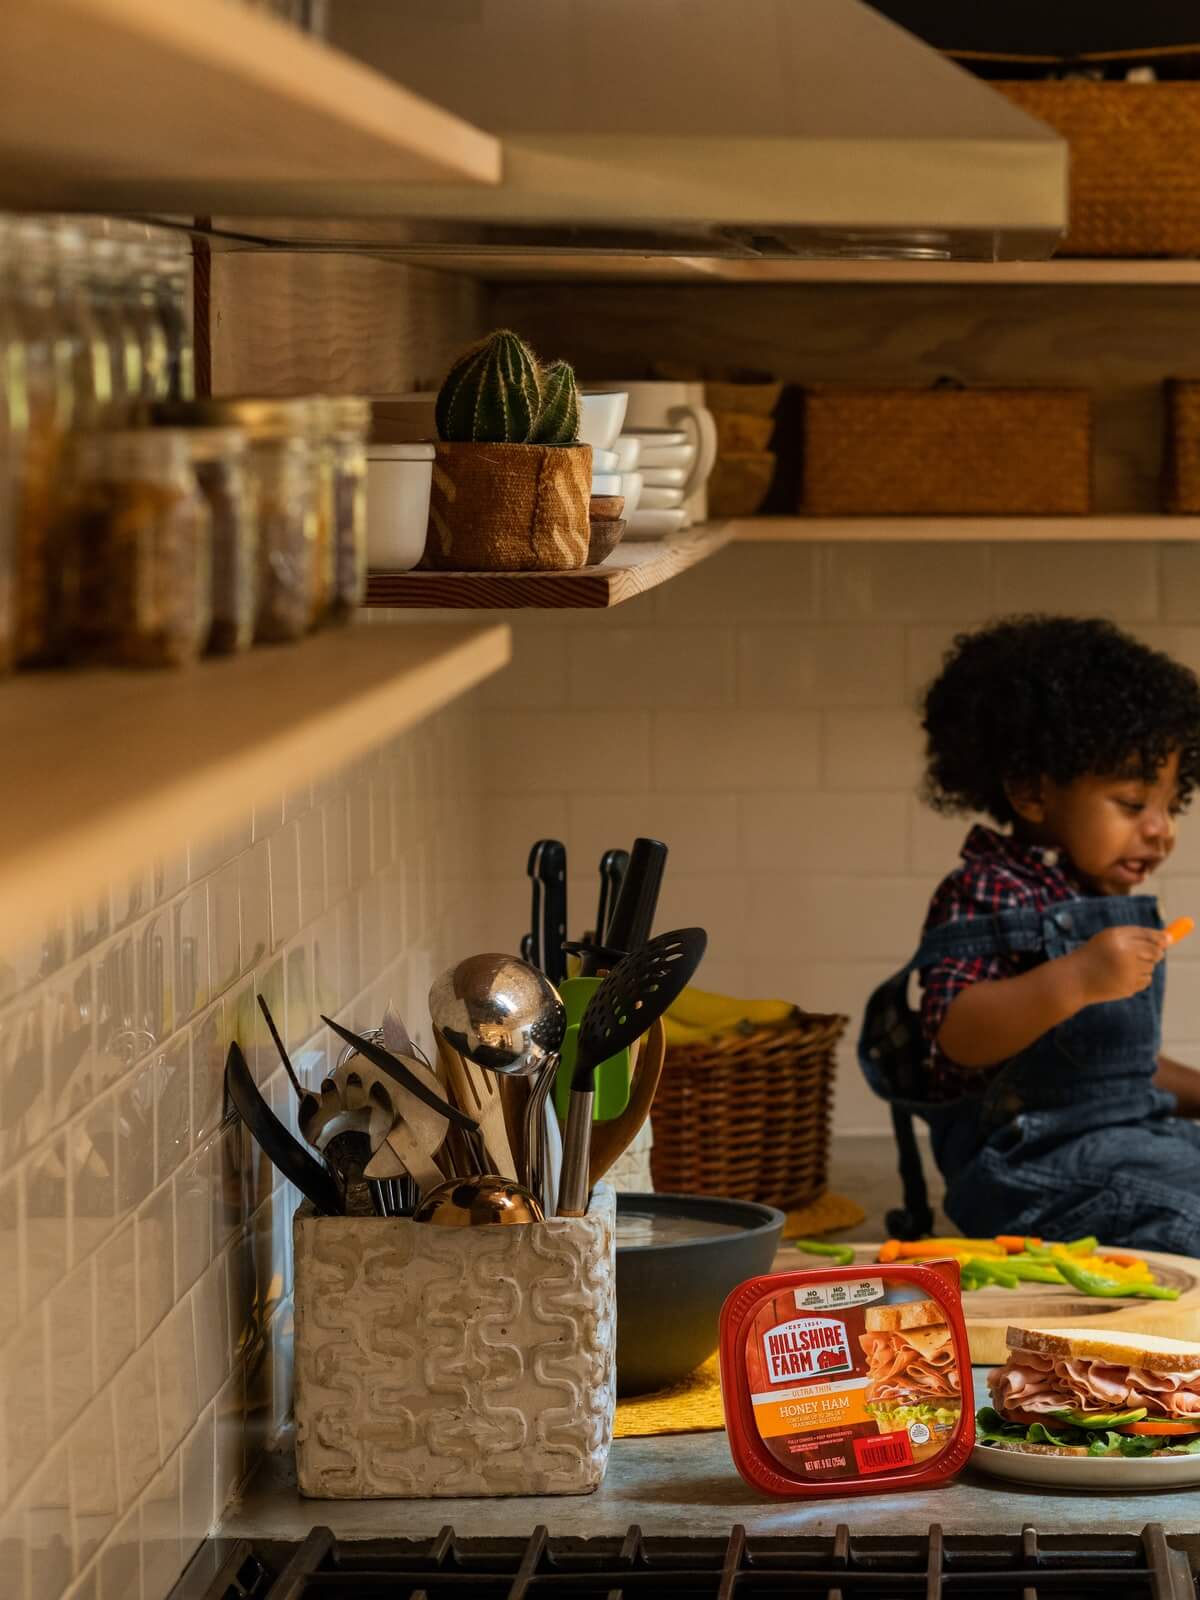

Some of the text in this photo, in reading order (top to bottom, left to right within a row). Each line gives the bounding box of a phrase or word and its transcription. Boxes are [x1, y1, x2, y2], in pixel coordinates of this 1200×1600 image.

[768, 1325, 844, 1355] HILLSHIRE
[771, 1351, 813, 1377] FARM
[792, 1384, 832, 1398] ULTRA THIN
[779, 1396, 850, 1418] HONEY HAM
[804, 1460, 814, 1471] NET
